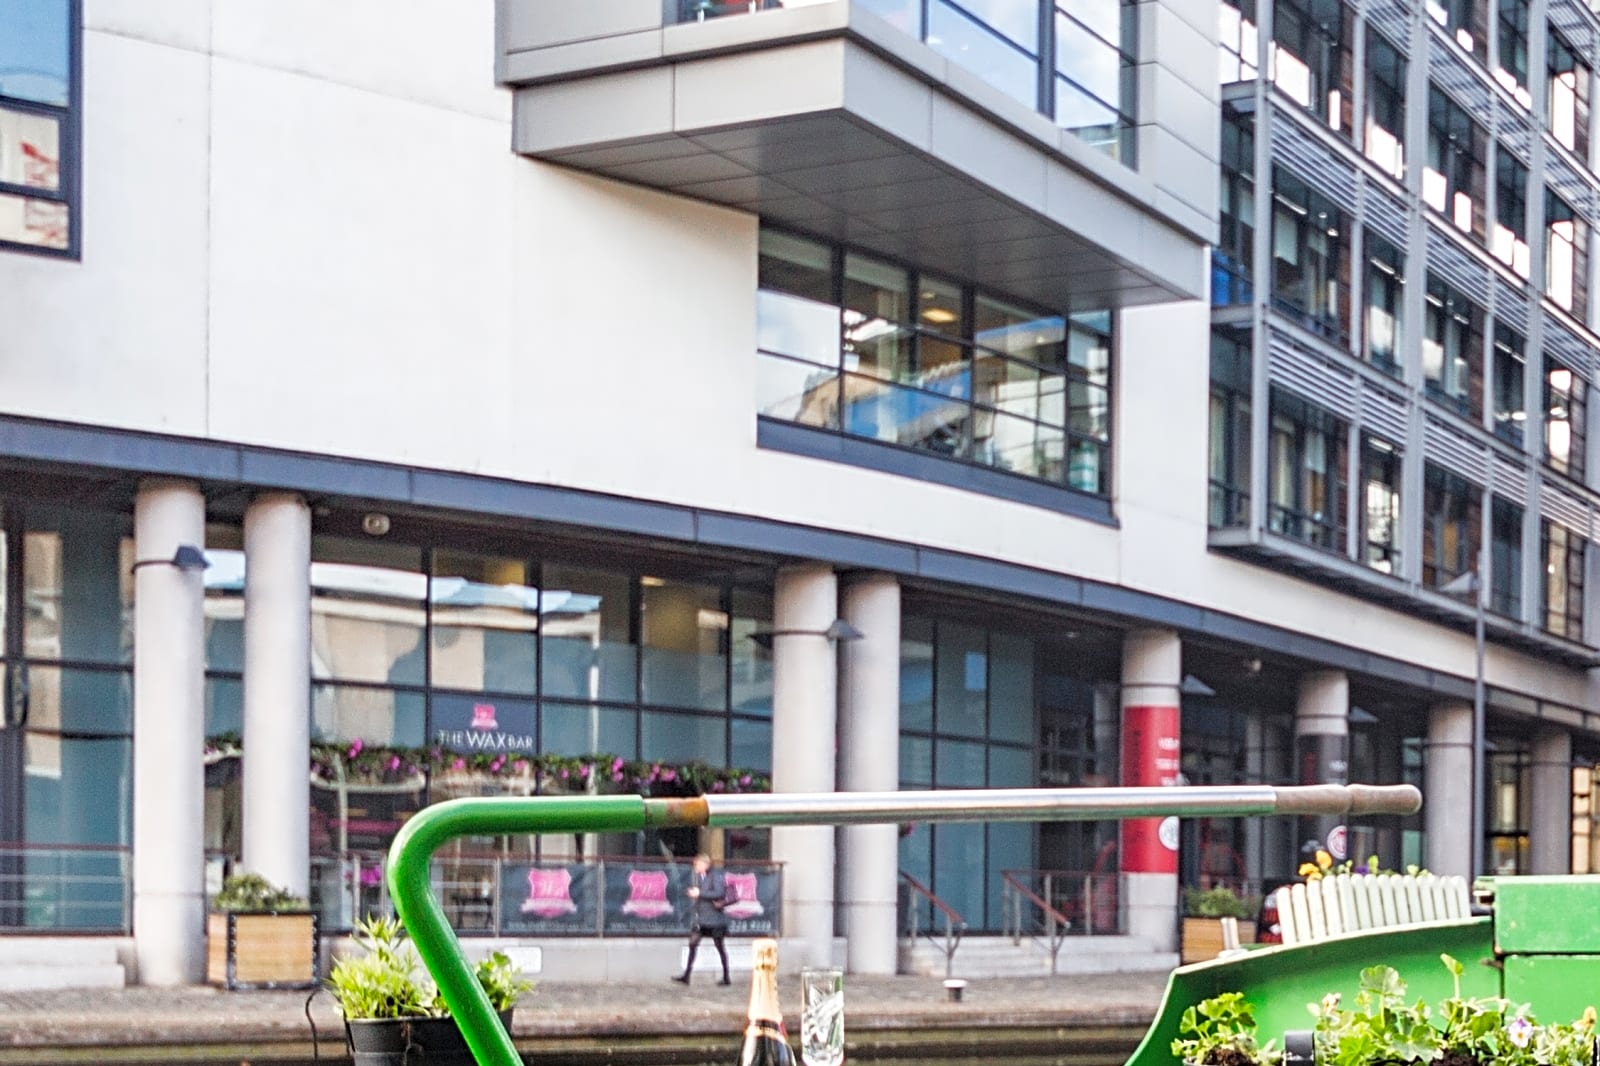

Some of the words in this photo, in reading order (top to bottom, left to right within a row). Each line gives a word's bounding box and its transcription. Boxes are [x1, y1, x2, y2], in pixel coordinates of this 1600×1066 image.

[439, 729, 464, 745] THE
[466, 730, 506, 749] WAX
[508, 734, 533, 749] BAR
